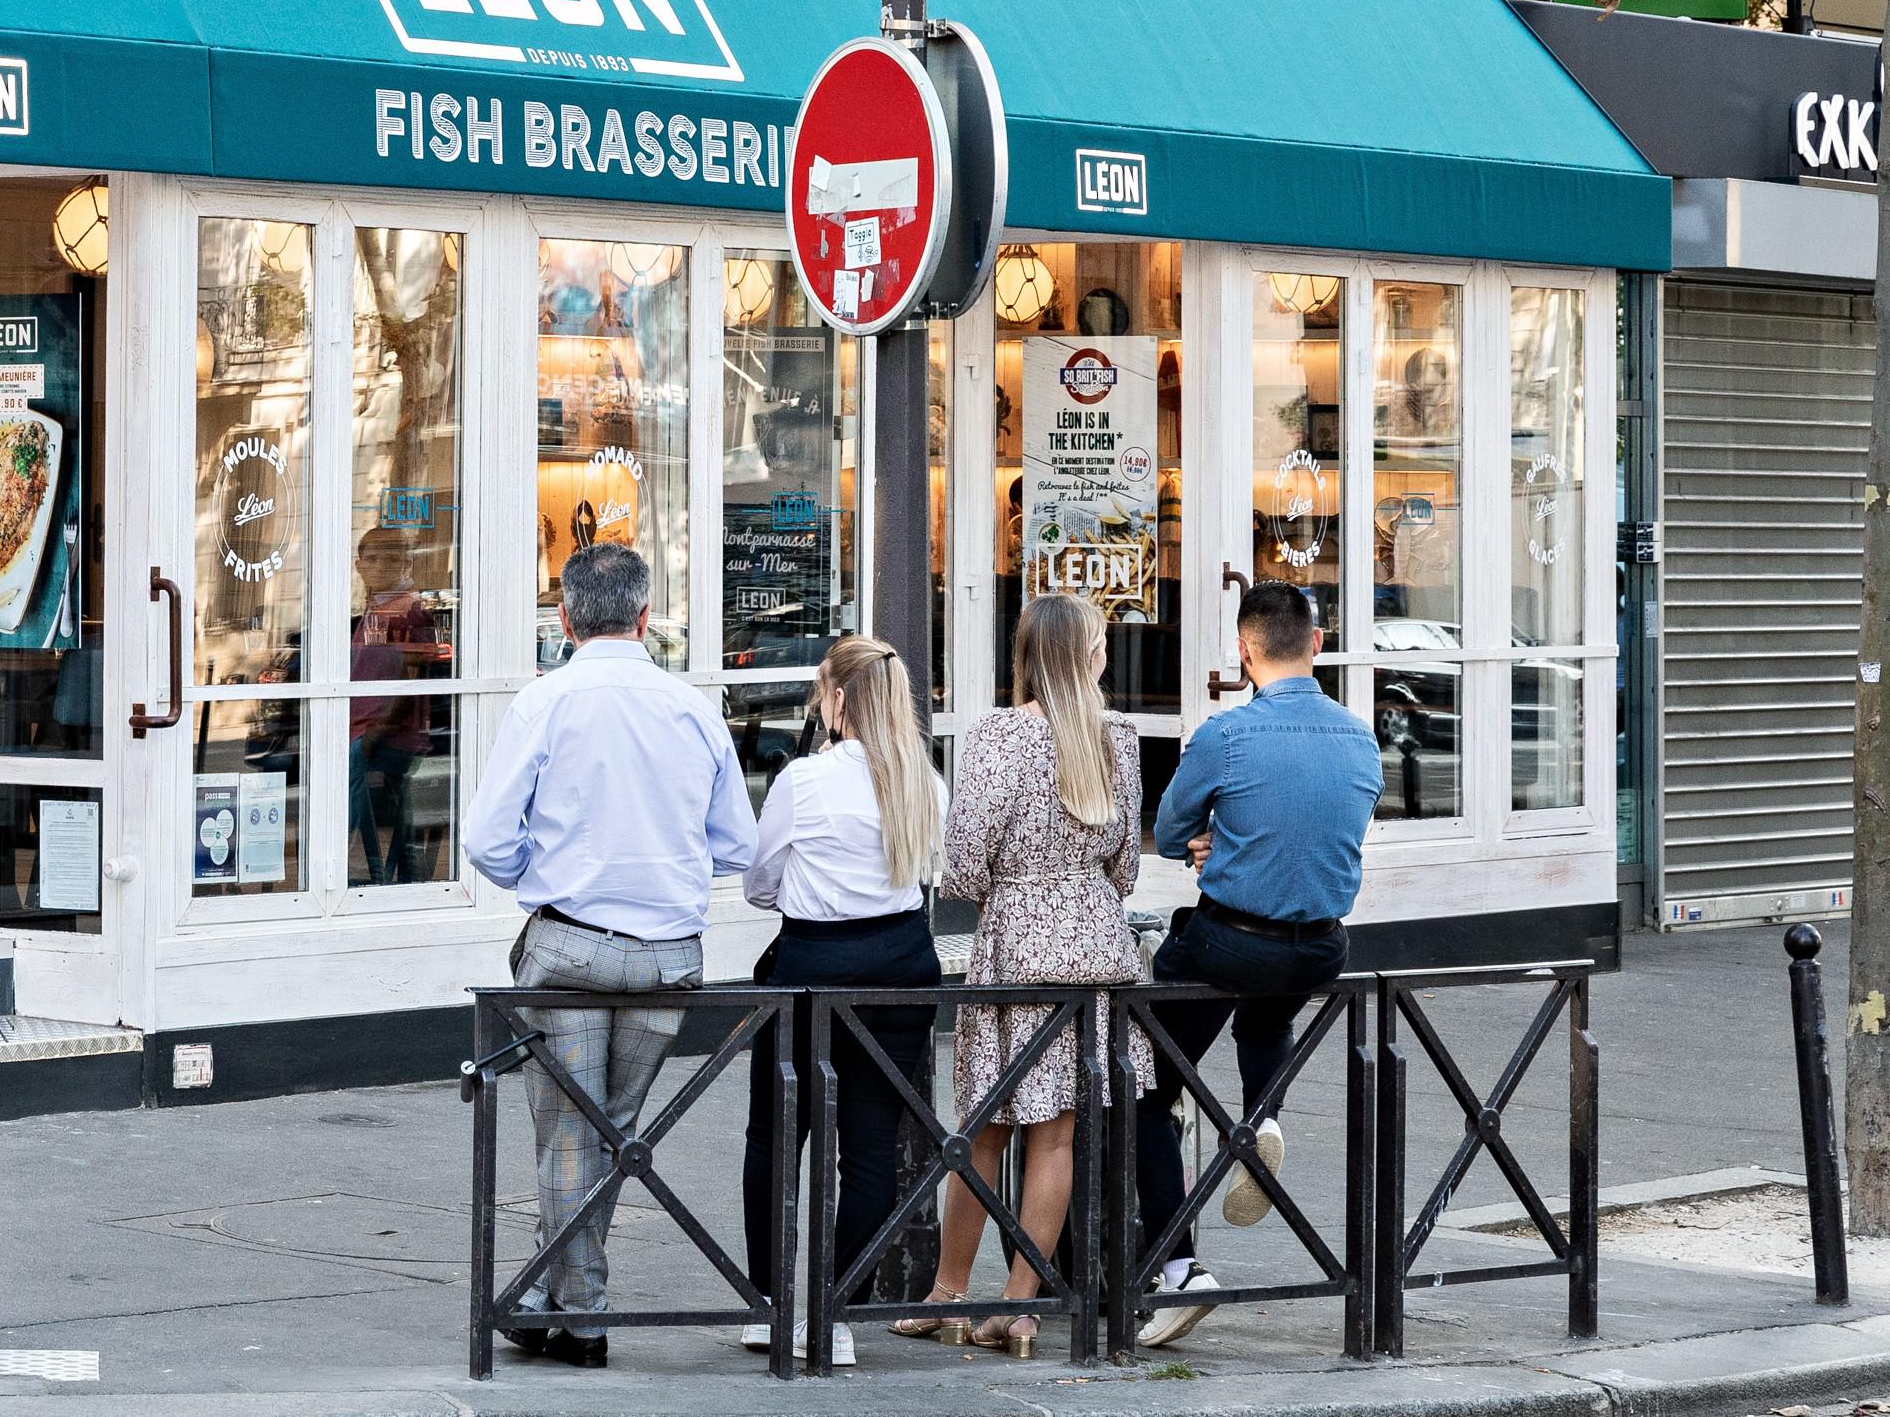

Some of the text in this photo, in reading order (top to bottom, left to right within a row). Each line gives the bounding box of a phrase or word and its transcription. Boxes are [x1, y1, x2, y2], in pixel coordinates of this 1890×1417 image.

[527, 46, 631, 73] DEPUIS 1893
[374, 89, 504, 167] FISH
[1084, 161, 1139, 203] LÉON
[774, 339, 820, 350] BRASSERIE
[1064, 370, 1075, 383] SO
[1057, 408, 1109, 429] LÉON IS IN
[1048, 433, 1068, 450] THE
[223, 437, 287, 475] MOULES
[1275, 449, 1326, 491] COCKTAILS
[1038, 480, 1071, 491] Retrouvez
[224, 549, 284, 583] FRITES
